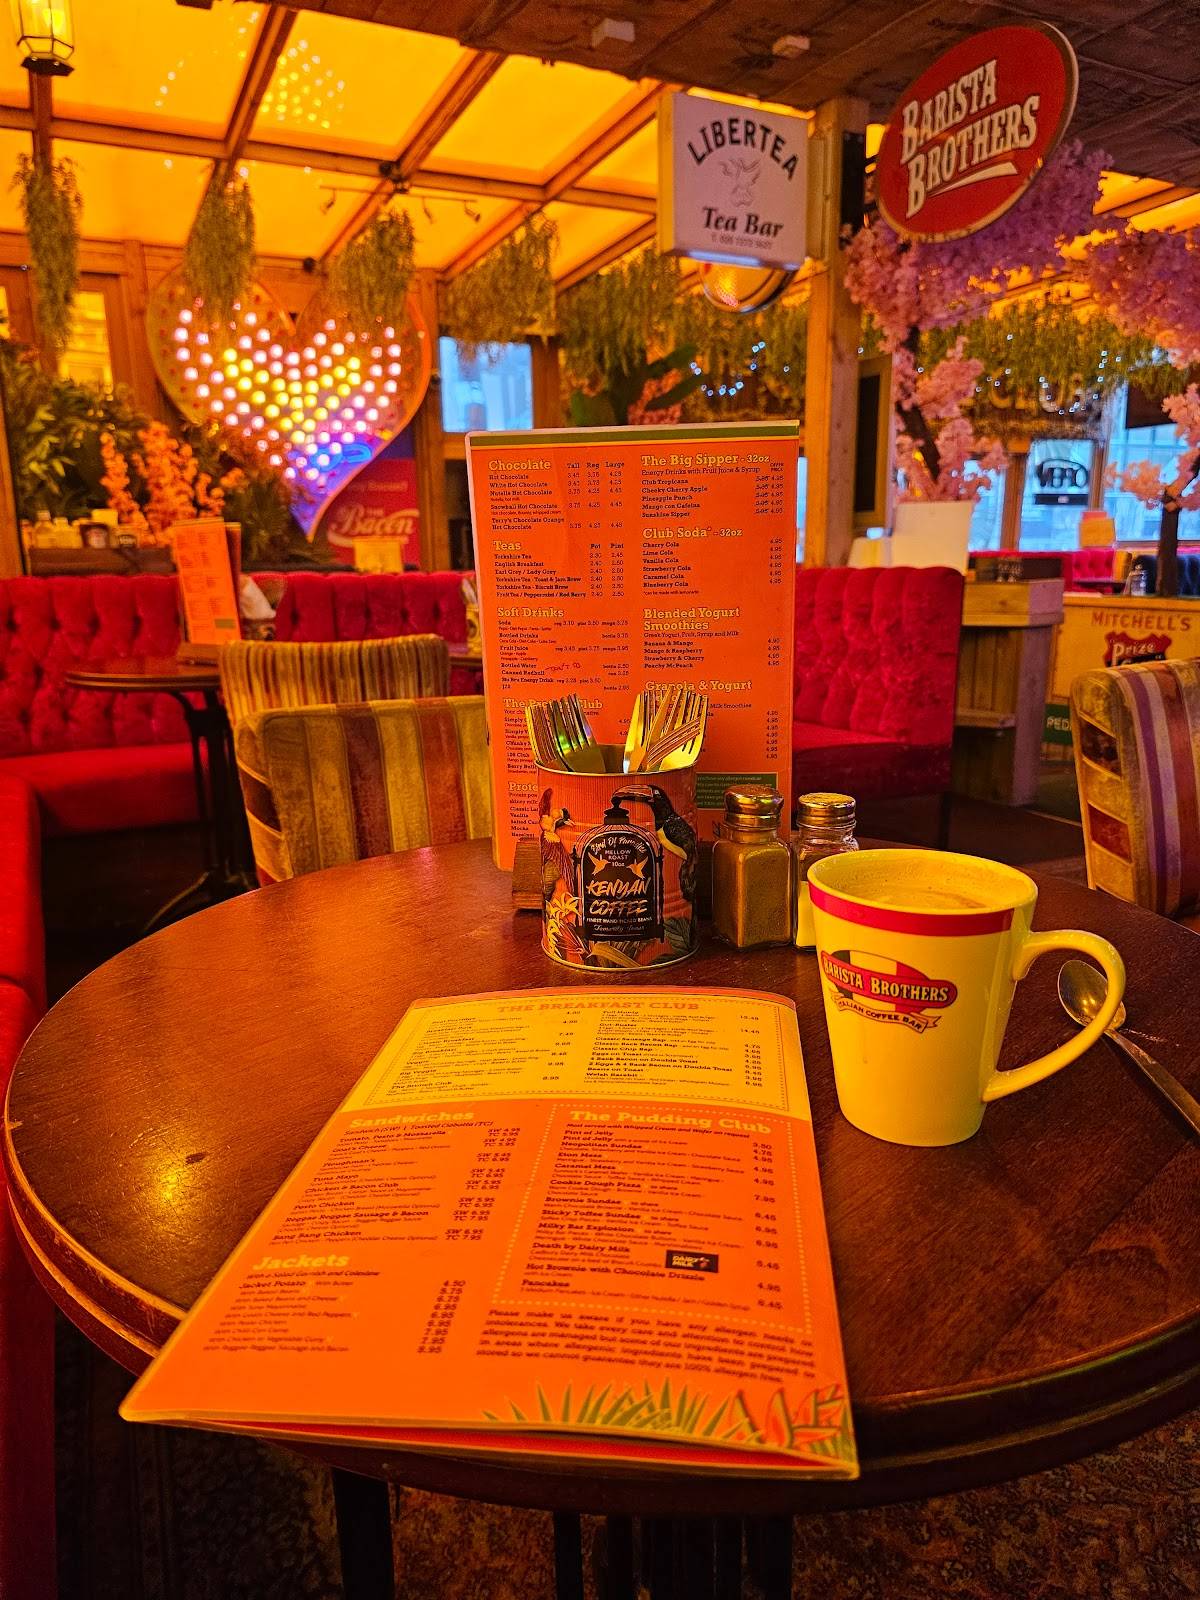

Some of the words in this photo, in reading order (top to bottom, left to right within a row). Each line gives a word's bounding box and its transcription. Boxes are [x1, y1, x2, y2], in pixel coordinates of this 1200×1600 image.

[900, 59, 997, 165] BARISTA
[688, 118, 799, 181] LIBERTEA
[905, 95, 1040, 219] BROTHERS
[703, 206, 736, 232] Tea
[745, 212, 784, 237] Bar
[489, 459, 551, 471] Chocolate
[642, 455, 666, 466] The
[670, 455, 692, 467] Big
[696, 454, 738, 467] Sipper
[747, 455, 769, 463] 32oz
[643, 528, 674, 538] Club
[720, 528, 742, 536] 32oz
[493, 541, 521, 550] Teas
[498, 607, 519, 617] Soft
[523, 608, 564, 617] Drinks
[644, 608, 696, 619] Blended
[698, 607, 740, 620] Yogurt
[644, 620, 709, 631] Smoothies
[1091, 611, 1191, 631] MITCHELL'S
[1111, 642, 1156, 667] Prize
[645, 681, 695, 691] Granola
[699, 681, 708, 690] &
[710, 681, 752, 692] Yogurt
[586, 877, 651, 899] KENYAN
[589, 899, 648, 915] COFFEE
[823, 957, 863, 989] BARISTA
[871, 977, 948, 1001] BROTHERS
[538, 1001, 642, 1011] BREAKFAST
[649, 1002, 699, 1010] CLUB
[866, 1011, 899, 1021] COFFEE
[903, 1016, 923, 1029] BAR
[350, 1111, 474, 1127] Sandwiches
[570, 1111, 611, 1120] The
[618, 1111, 713, 1128] Pudding
[719, 1119, 771, 1134] Club
[252, 1255, 350, 1270] Jackets
[546, 1264, 586, 1272] Brownie
[613, 1268, 666, 1278] Chocolate
[522, 1279, 570, 1287] Pancakes
